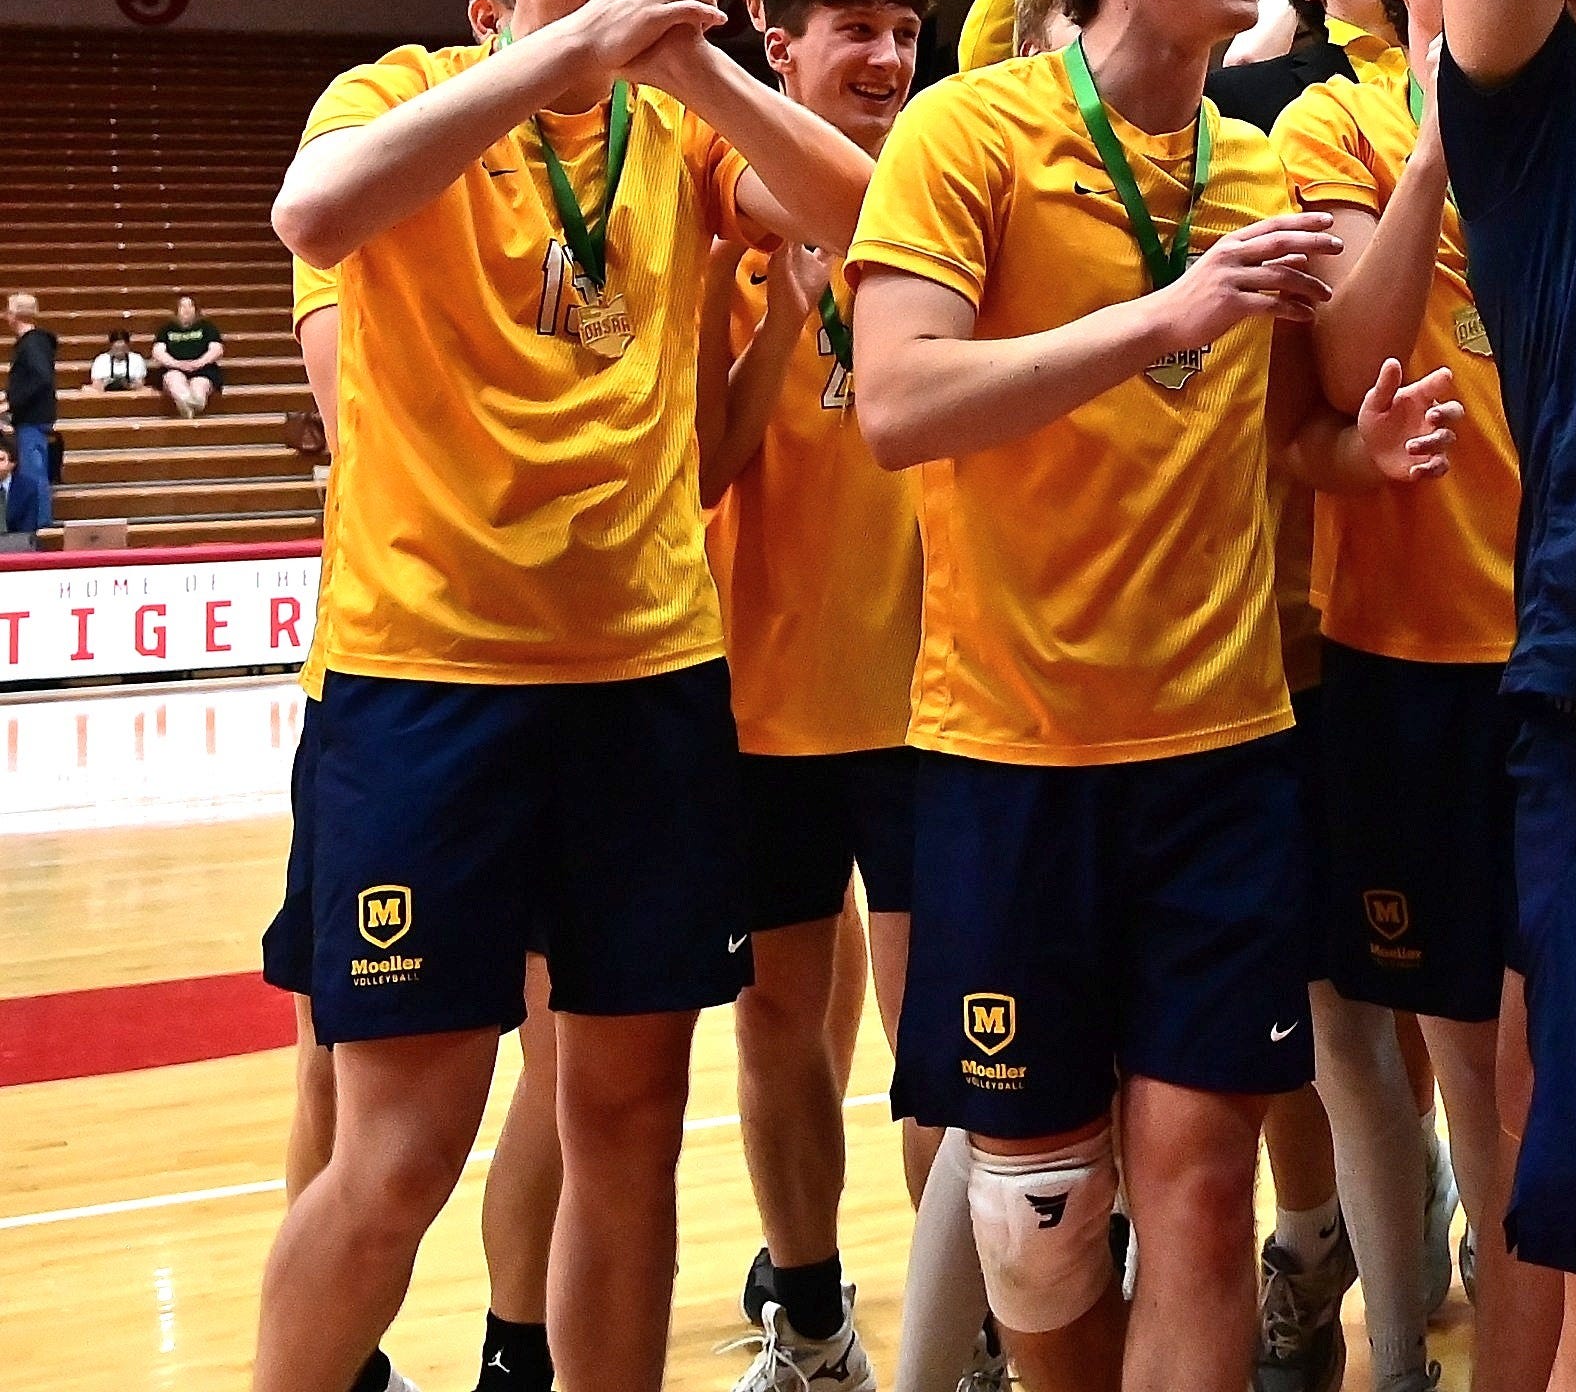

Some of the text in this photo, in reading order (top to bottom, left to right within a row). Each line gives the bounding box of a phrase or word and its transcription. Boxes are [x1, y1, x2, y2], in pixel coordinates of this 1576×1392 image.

[584, 314, 632, 341] OHSAA
[59, 577, 149, 598] HOME
[367, 898, 401, 928] M
[350, 955, 423, 976] Moeller
[353, 973, 420, 987] VOLLEYBALL
[972, 1006, 1006, 1034] M
[960, 1060, 1027, 1079] Moeller
[966, 1076, 1024, 1090] VOLLEYBALL
